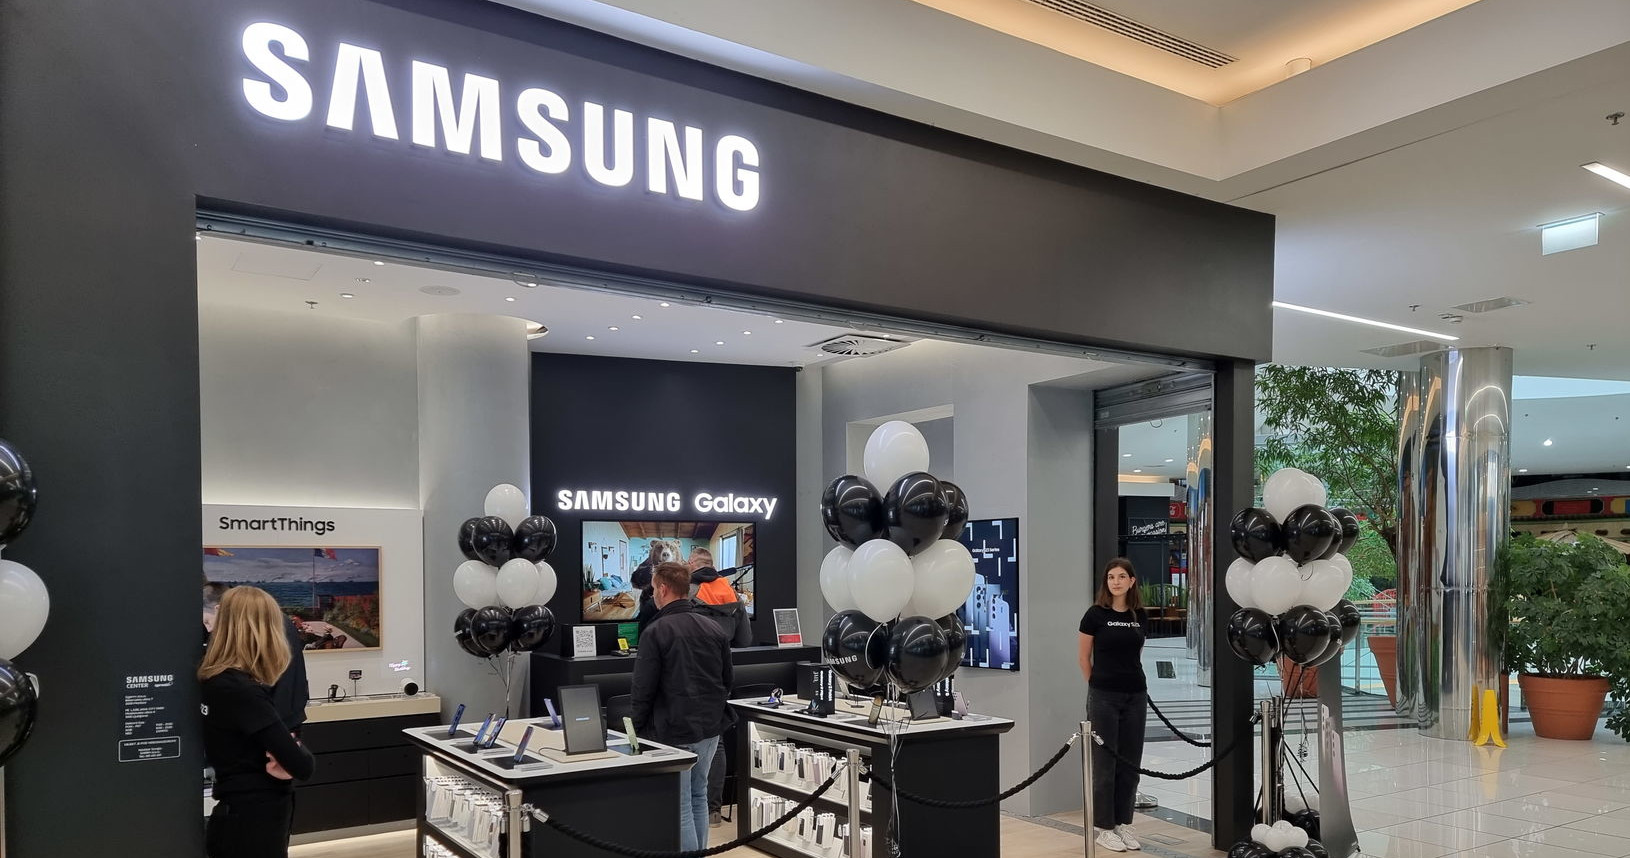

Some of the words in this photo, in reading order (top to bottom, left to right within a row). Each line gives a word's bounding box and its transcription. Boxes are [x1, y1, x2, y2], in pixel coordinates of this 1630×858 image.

[241, 21, 762, 213] SAMSUNG
[557, 489, 681, 512] SAMSUNG
[694, 493, 778, 520] Galaxy
[218, 516, 336, 536] SmartThings
[1107, 620, 1131, 628] Galaxy
[126, 674, 174, 683] SAMSUNG
